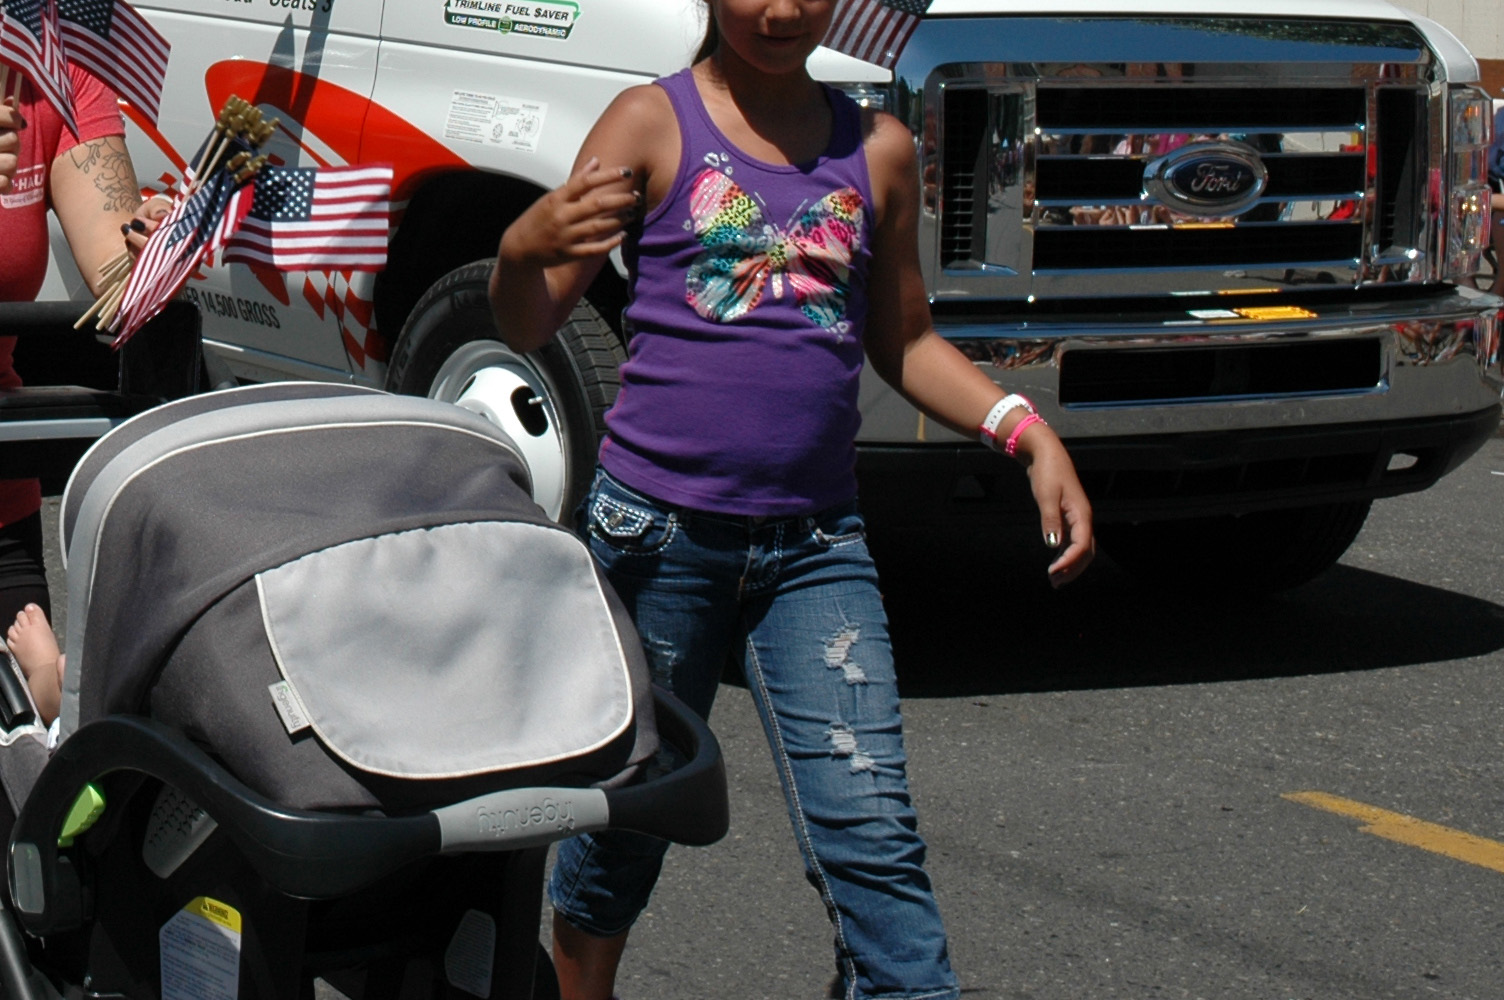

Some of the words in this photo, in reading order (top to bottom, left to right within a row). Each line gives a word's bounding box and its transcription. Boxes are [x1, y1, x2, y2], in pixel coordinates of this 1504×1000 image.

[504, 4, 531, 17] FUEL
[452, 15, 467, 25] LOW
[468, 18, 496, 28] PROFILE
[1191, 163, 1242, 192] Ford
[201, 290, 238, 319] 14,500
[237, 298, 280, 329] GROSS
